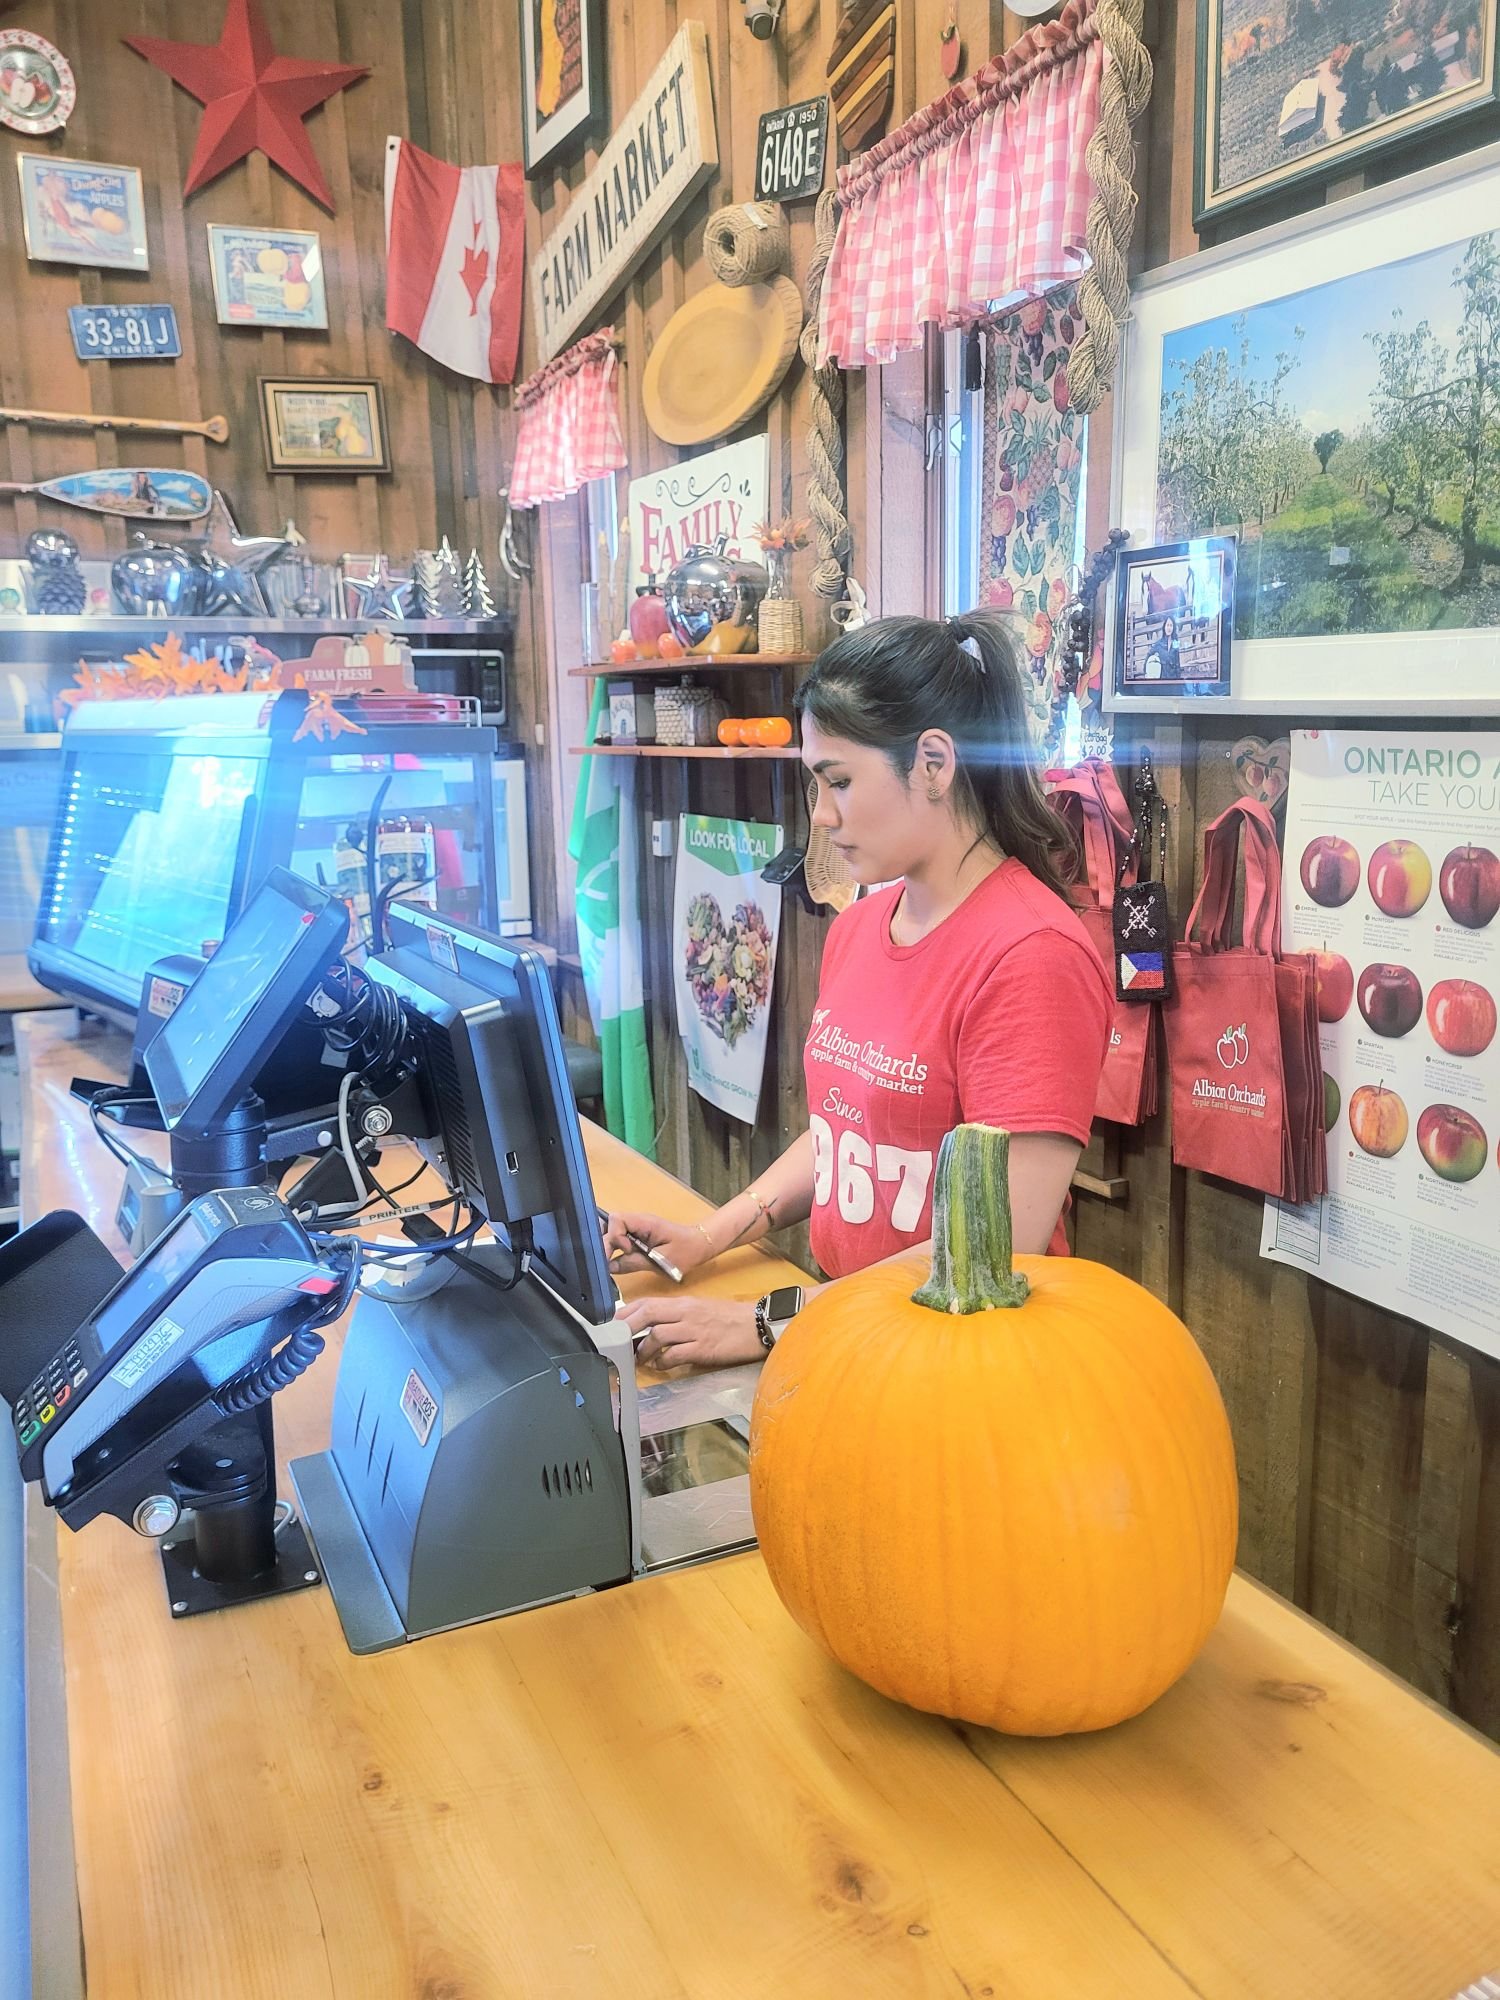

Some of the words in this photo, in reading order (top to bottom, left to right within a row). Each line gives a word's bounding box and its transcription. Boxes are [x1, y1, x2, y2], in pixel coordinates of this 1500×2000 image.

[766, 119, 785, 133] ONTARIO
[800, 110, 817, 124] 1950
[761, 127, 820, 194] 6148E
[541, 211, 593, 337] FARM
[594, 61, 687, 265] MARKET
[640, 500, 742, 574] FAMILY
[304, 669, 336, 682] FARM
[337, 668, 372, 681] FRESH
[1344, 746, 1481, 779] ONTARIO
[1368, 780, 1430, 807] TAKE
[1440, 784, 1500, 811] YOU
[689, 829, 716, 849] LOOK
[717, 833, 737, 853] FOR
[738, 836, 770, 858] LOCAL
[1454, 928, 1481, 937] DELICIOUS
[815, 1025, 860, 1059] Albion
[860, 1041, 928, 1081] Orchards
[810, 1047, 833, 1063] apple
[834, 1054, 852, 1071] farm
[852, 1061, 858, 1073] &
[876, 1076, 925, 1095] market
[822, 1086, 864, 1125] Since
[1192, 1079, 1226, 1100] Albion
[1228, 1083, 1267, 1107] Orchards
[1192, 1098, 1210, 1108] apple
[1229, 1104, 1251, 1117] country
[1425, 1177, 1452, 1189] NORTHERN
[369, 1204, 421, 1221] PRINTER
[1348, 1202, 1376, 1217] VARIETIES
[1428, 1231, 1456, 1245] STORAGE
[1458, 1242, 1470, 1252] AND
[423, 1397, 436, 1417] POS
